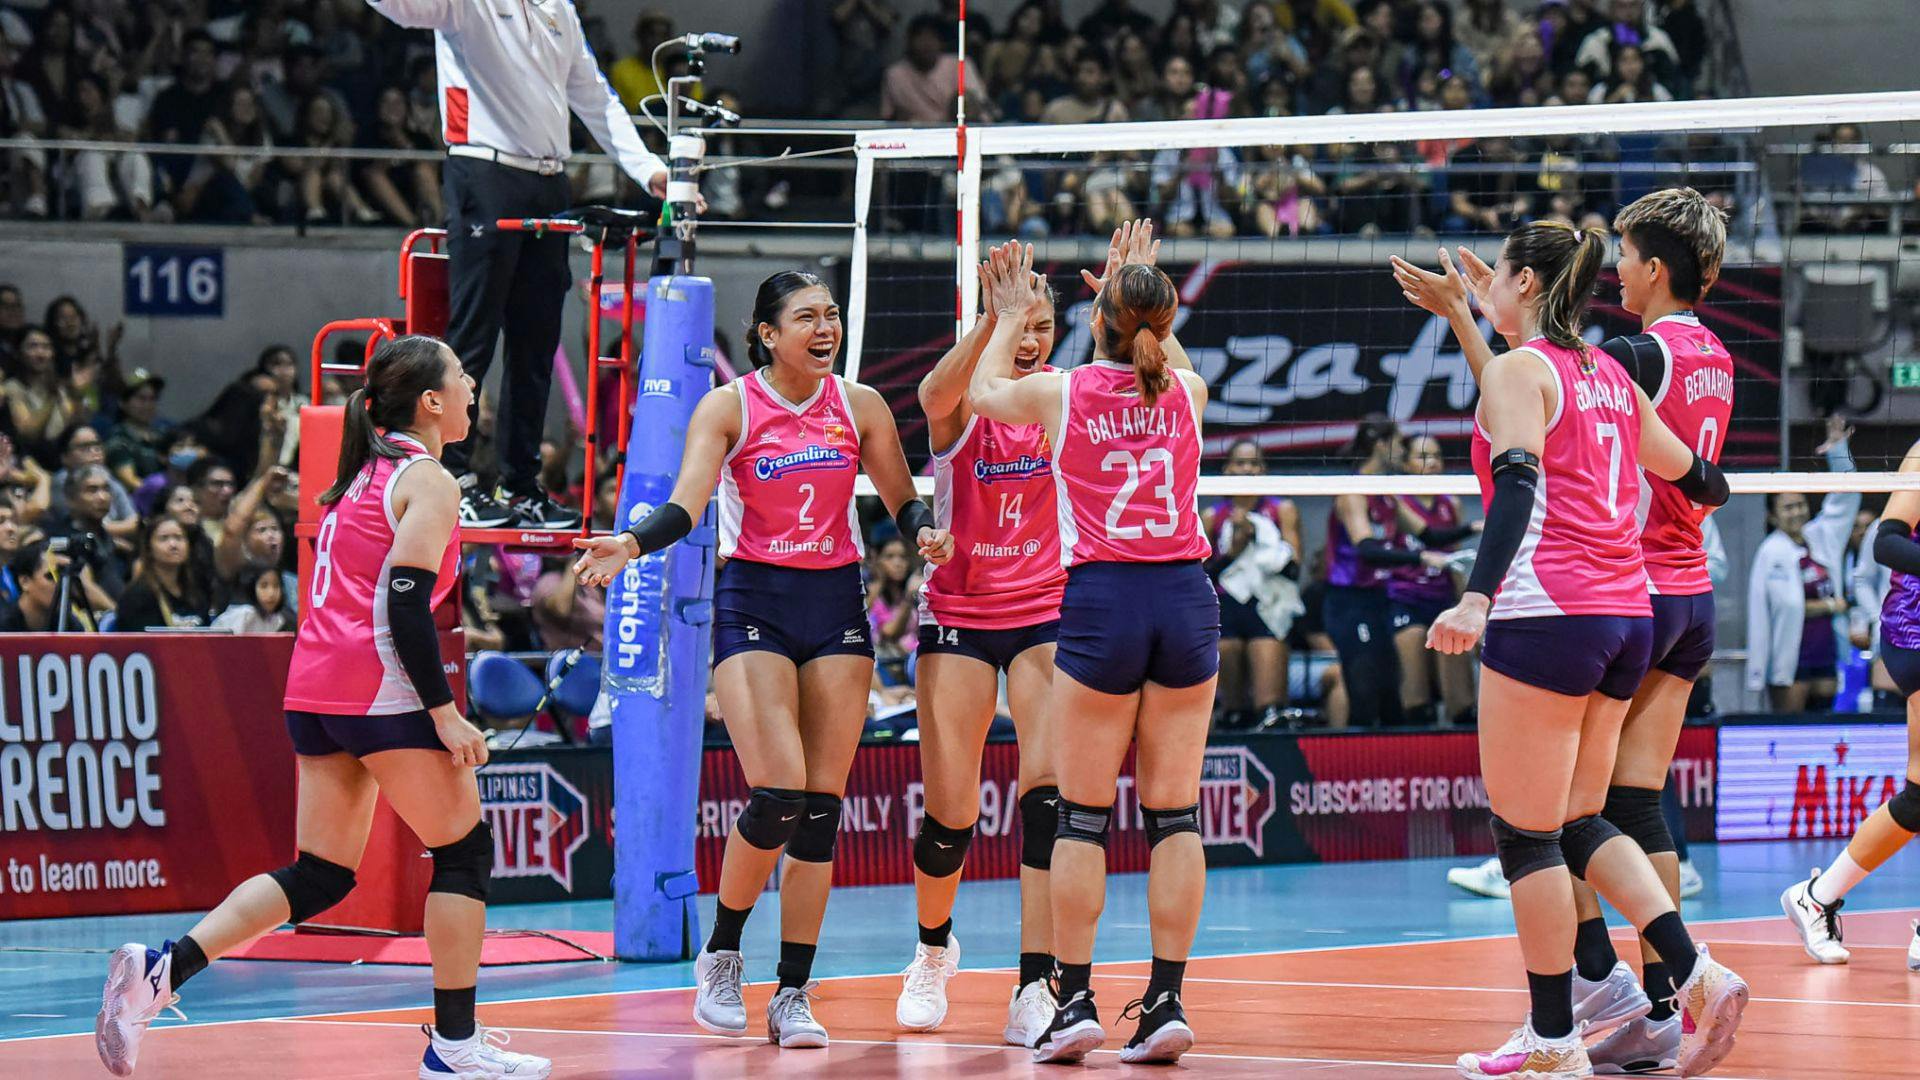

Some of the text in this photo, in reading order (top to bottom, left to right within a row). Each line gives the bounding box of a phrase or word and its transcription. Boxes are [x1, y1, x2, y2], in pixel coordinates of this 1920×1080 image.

[129, 256, 218, 304] 116
[1685, 367, 1733, 405] BERNARDO
[1087, 407, 1167, 445] GALANZA
[755, 447, 838, 481] Creamline
[1596, 423, 1621, 519] 7
[799, 483, 815, 525] 2
[999, 493, 1024, 528] 14
[1101, 448, 1179, 540] 23
[312, 512, 338, 608] 8
[768, 539, 820, 553] Allianz
[972, 542, 1020, 557] Allianz
[937, 626, 959, 645] 14
[0, 652, 158, 742] LIPINO
[0, 740, 167, 832] RENCE
[1289, 778, 1406, 815] SUBSCRIBE
[1409, 776, 1450, 811] FOR
[8, 857, 34, 893] to
[39, 854, 98, 892] learn
[105, 858, 167, 889] more.
